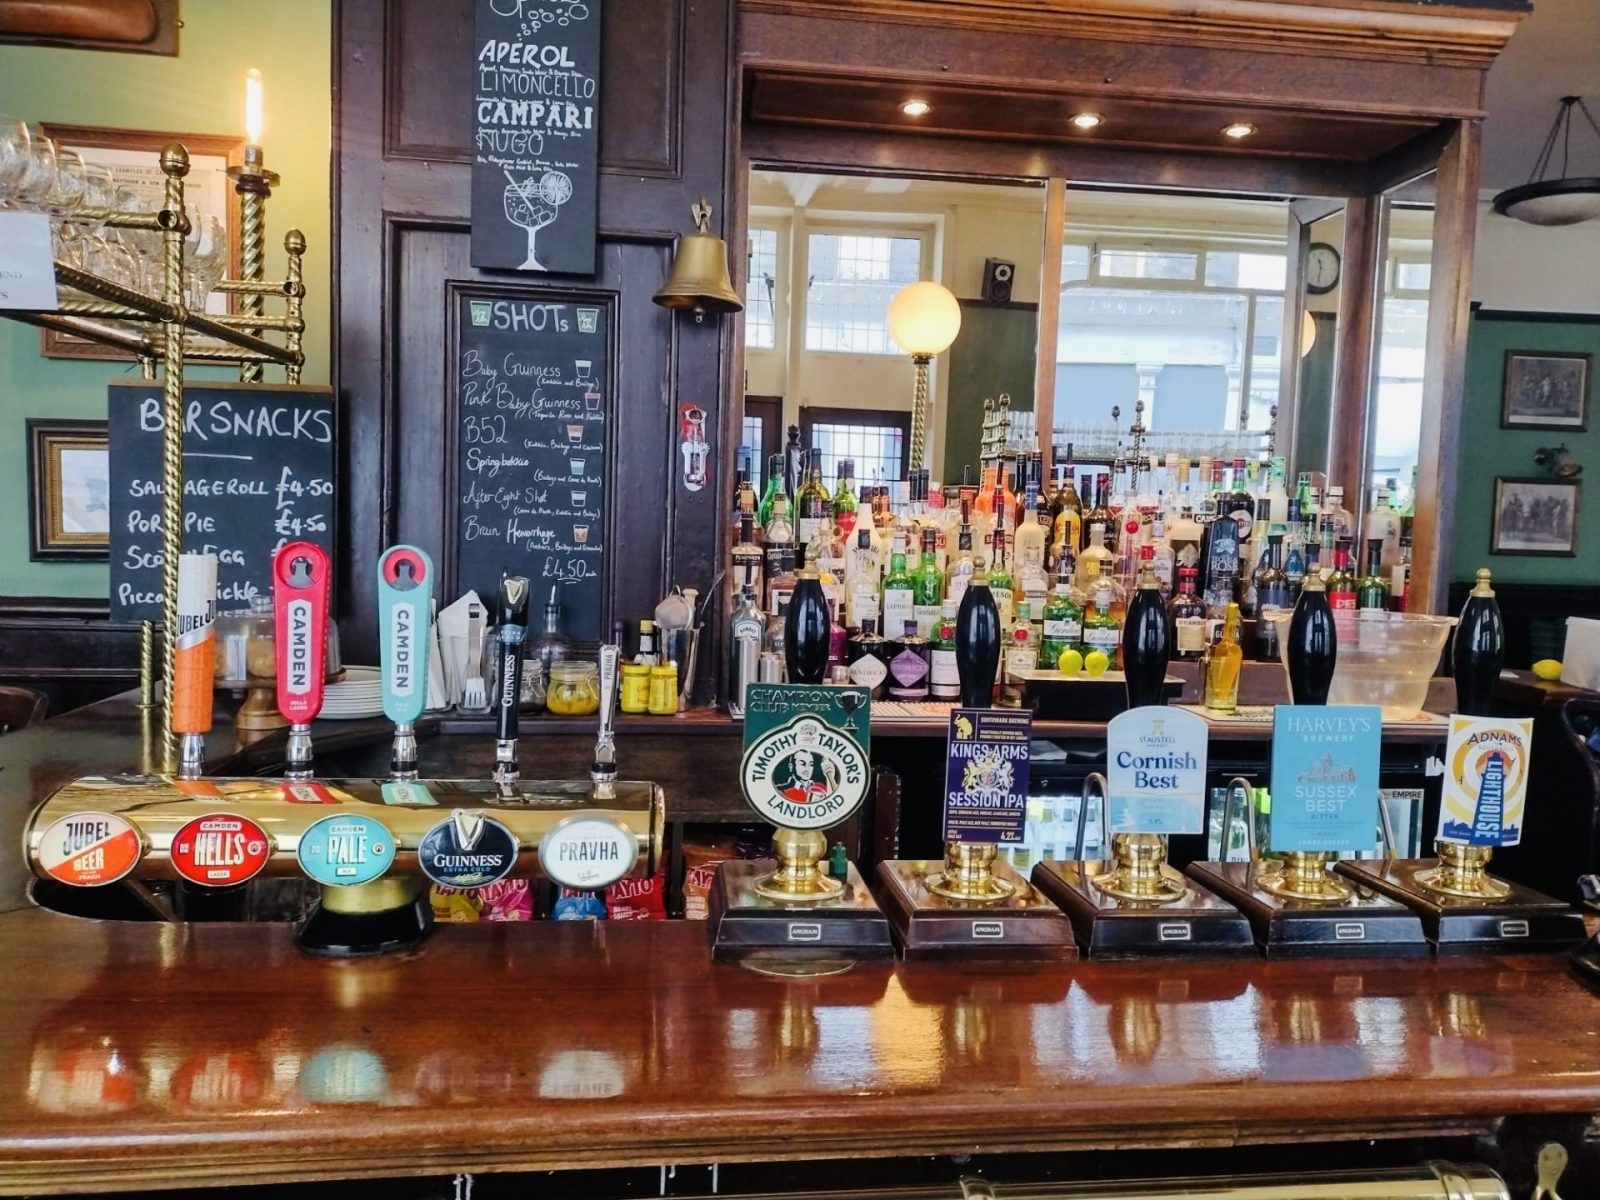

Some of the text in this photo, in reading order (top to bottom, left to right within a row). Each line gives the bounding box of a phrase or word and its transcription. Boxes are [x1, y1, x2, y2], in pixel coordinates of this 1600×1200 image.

[479, 40, 575, 68] APEROL
[481, 72, 595, 98] LIMONCELLO
[478, 102, 593, 129] CAMPARI
[463, 350, 561, 392] Baby Guinness
[463, 381, 581, 419] Pink Baby Guinness
[140, 398, 332, 443] BR SNACKS
[464, 415, 508, 444] B52
[129, 479, 225, 497] SAUAGE
[275, 466, 333, 510] £4.50
[464, 481, 549, 510] After Eight Shot
[127, 509, 327, 536] POR PIE £4.50
[464, 515, 501, 541] Brain
[217, 581, 259, 601] ickle
[293, 606, 306, 687] CAMDEN
[396, 609, 410, 689] CAMDEN
[501, 654, 516, 708] GUINNESS
[750, 689, 835, 702] CHAMPION
[1287, 717, 1371, 732] HARVEY'S
[950, 743, 1028, 760] KINGS ARMS
[1468, 732, 1522, 747] ADNAMS
[752, 732, 860, 785] TIMOTHY TAYLOR'S
[1116, 751, 1198, 770] Cornish
[1135, 770, 1180, 789] Best
[1294, 785, 1358, 798] SUSSEX
[767, 794, 845, 819] LANDLORD
[948, 791, 1024, 809] SESSION IPA
[1305, 800, 1347, 812] BEST
[1392, 790, 1423, 798] EMPIRE
[1474, 760, 1503, 839] LIGHTHOUSE
[63, 822, 111, 856] JUBEL
[202, 822, 240, 830] CAMDEN
[73, 848, 104, 871] BEER
[195, 832, 247, 866] HELLS
[328, 836, 367, 864] PALE
[433, 854, 503, 868] GUINNESS
[559, 841, 619, 862] PRAVHA
